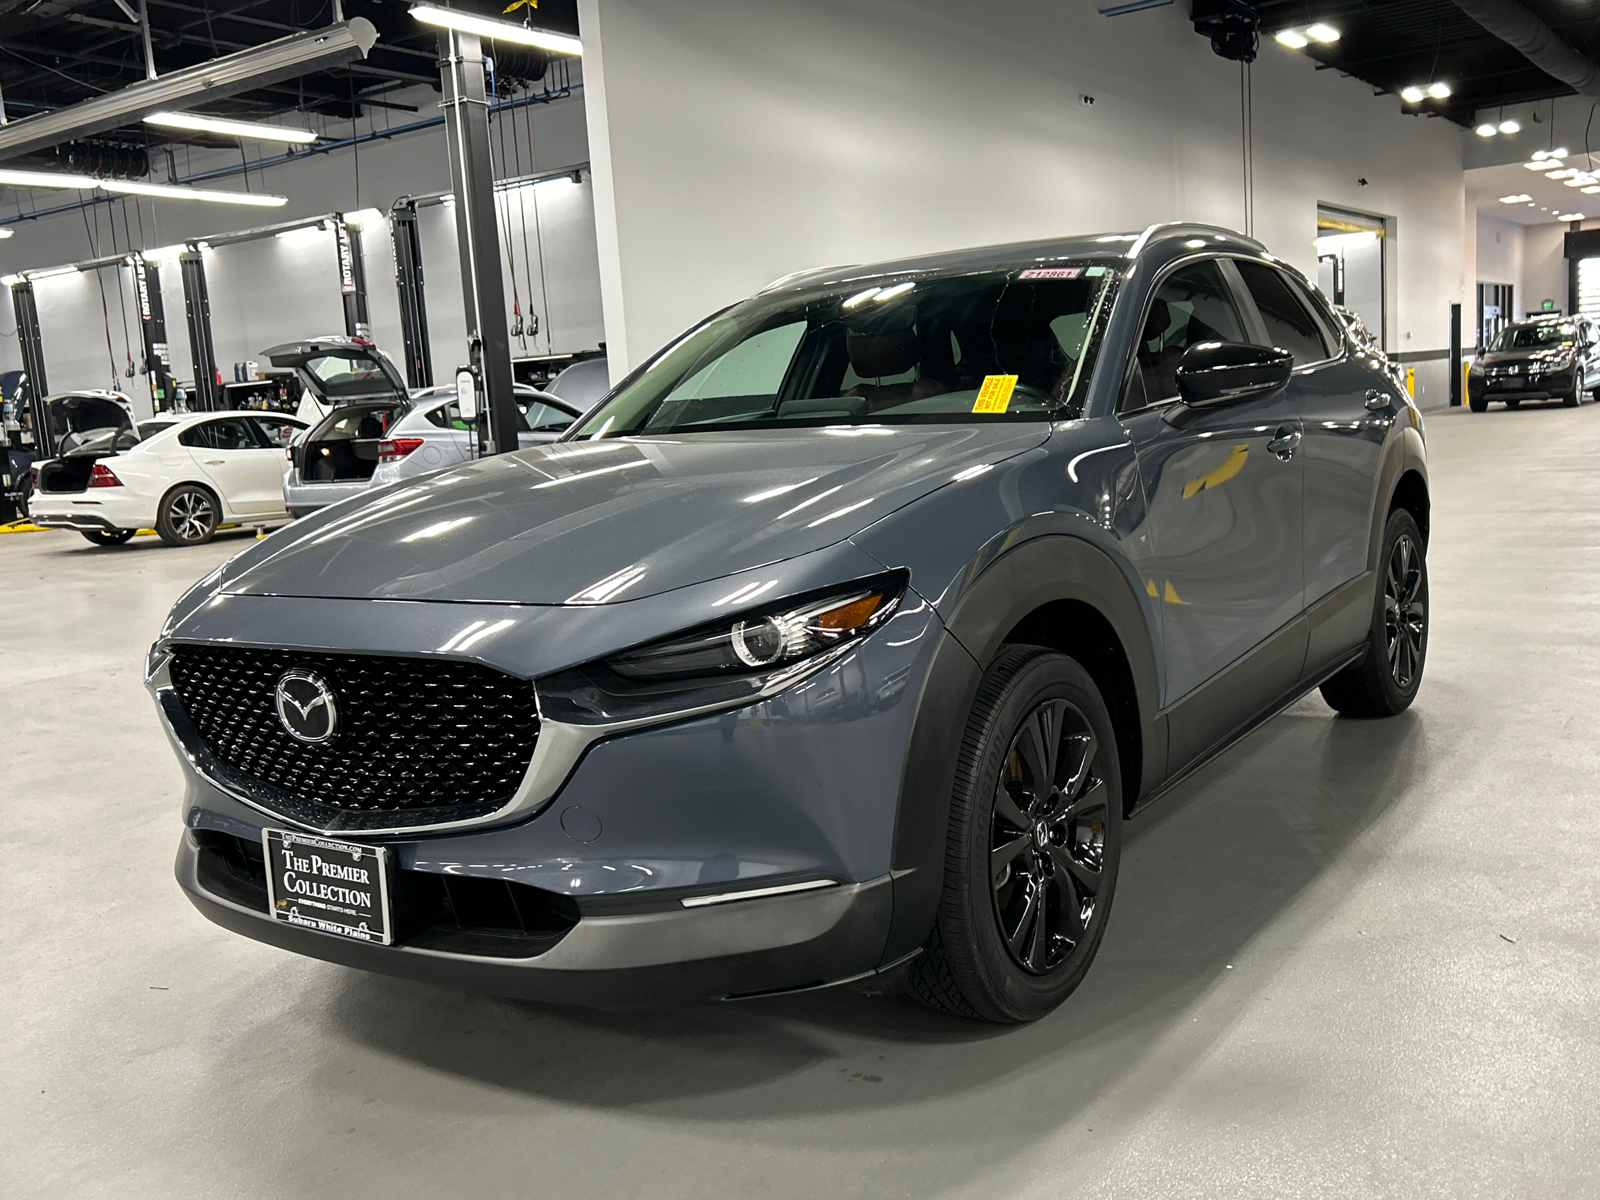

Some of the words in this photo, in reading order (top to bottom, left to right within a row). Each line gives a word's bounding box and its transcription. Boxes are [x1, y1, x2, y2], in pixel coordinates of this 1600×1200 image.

[340, 245, 352, 285] ROTARY
[139, 280, 151, 315] ROTARY
[975, 721, 1007, 885] RIDGESTONE
[288, 914, 317, 928] Subaru
[317, 921, 343, 933] White
[344, 926, 371, 941] Plains
